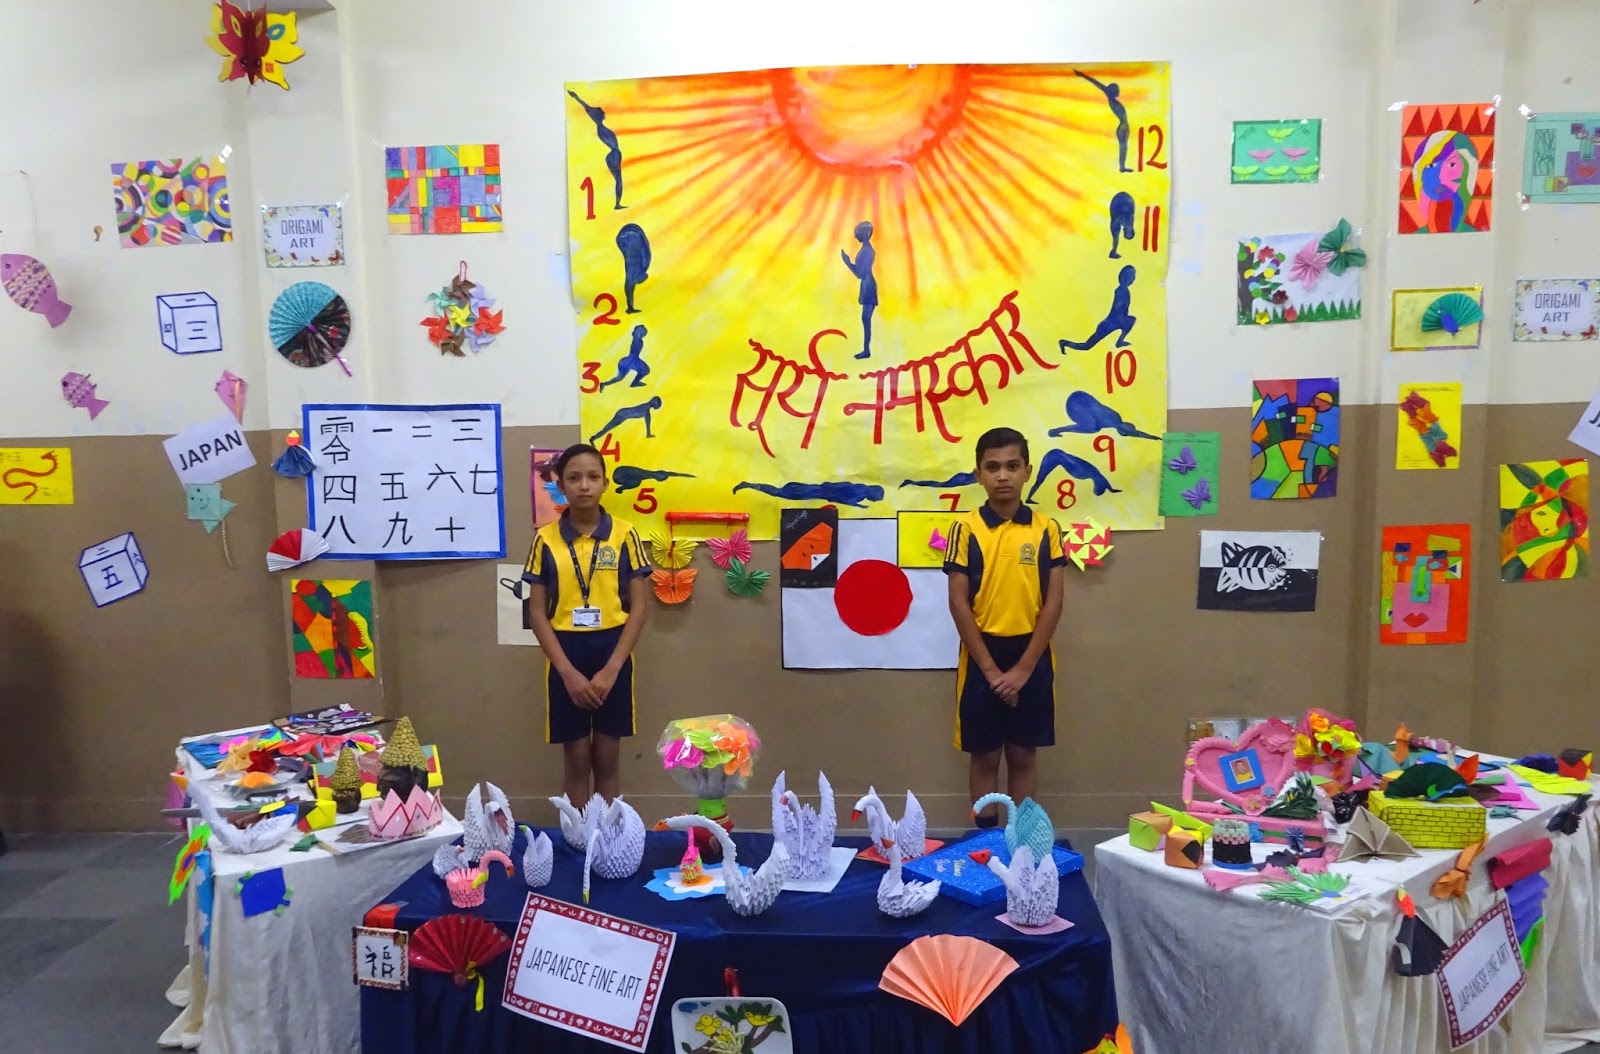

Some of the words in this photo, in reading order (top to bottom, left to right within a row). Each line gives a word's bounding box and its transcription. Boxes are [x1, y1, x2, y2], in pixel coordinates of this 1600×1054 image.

[1138, 125, 1167, 172] 12
[580, 176, 596, 220] 1
[281, 219, 324, 235] ORIGAMI
[289, 237, 316, 248] ART
[1143, 205, 1160, 253] 11
[593, 293, 621, 325] 2
[1534, 293, 1581, 309] ORIGAMI
[1542, 311, 1570, 322] ART
[580, 362, 601, 393] 3
[1105, 349, 1137, 394] 10
[730, 329, 848, 459] सूर्य
[179, 430, 242, 471] JAPAN
[600, 433, 620, 462] 4
[1093, 435, 1116, 472] 9
[633, 488, 658, 514] 5
[1057, 479, 1076, 509] 8
[526, 947, 590, 985] JAPANESE
[588, 965, 618, 993] FINE
[615, 974, 643, 1000] ART
[1458, 967, 1489, 1012] JAPANESE
[1496, 942, 1511, 967] ART
